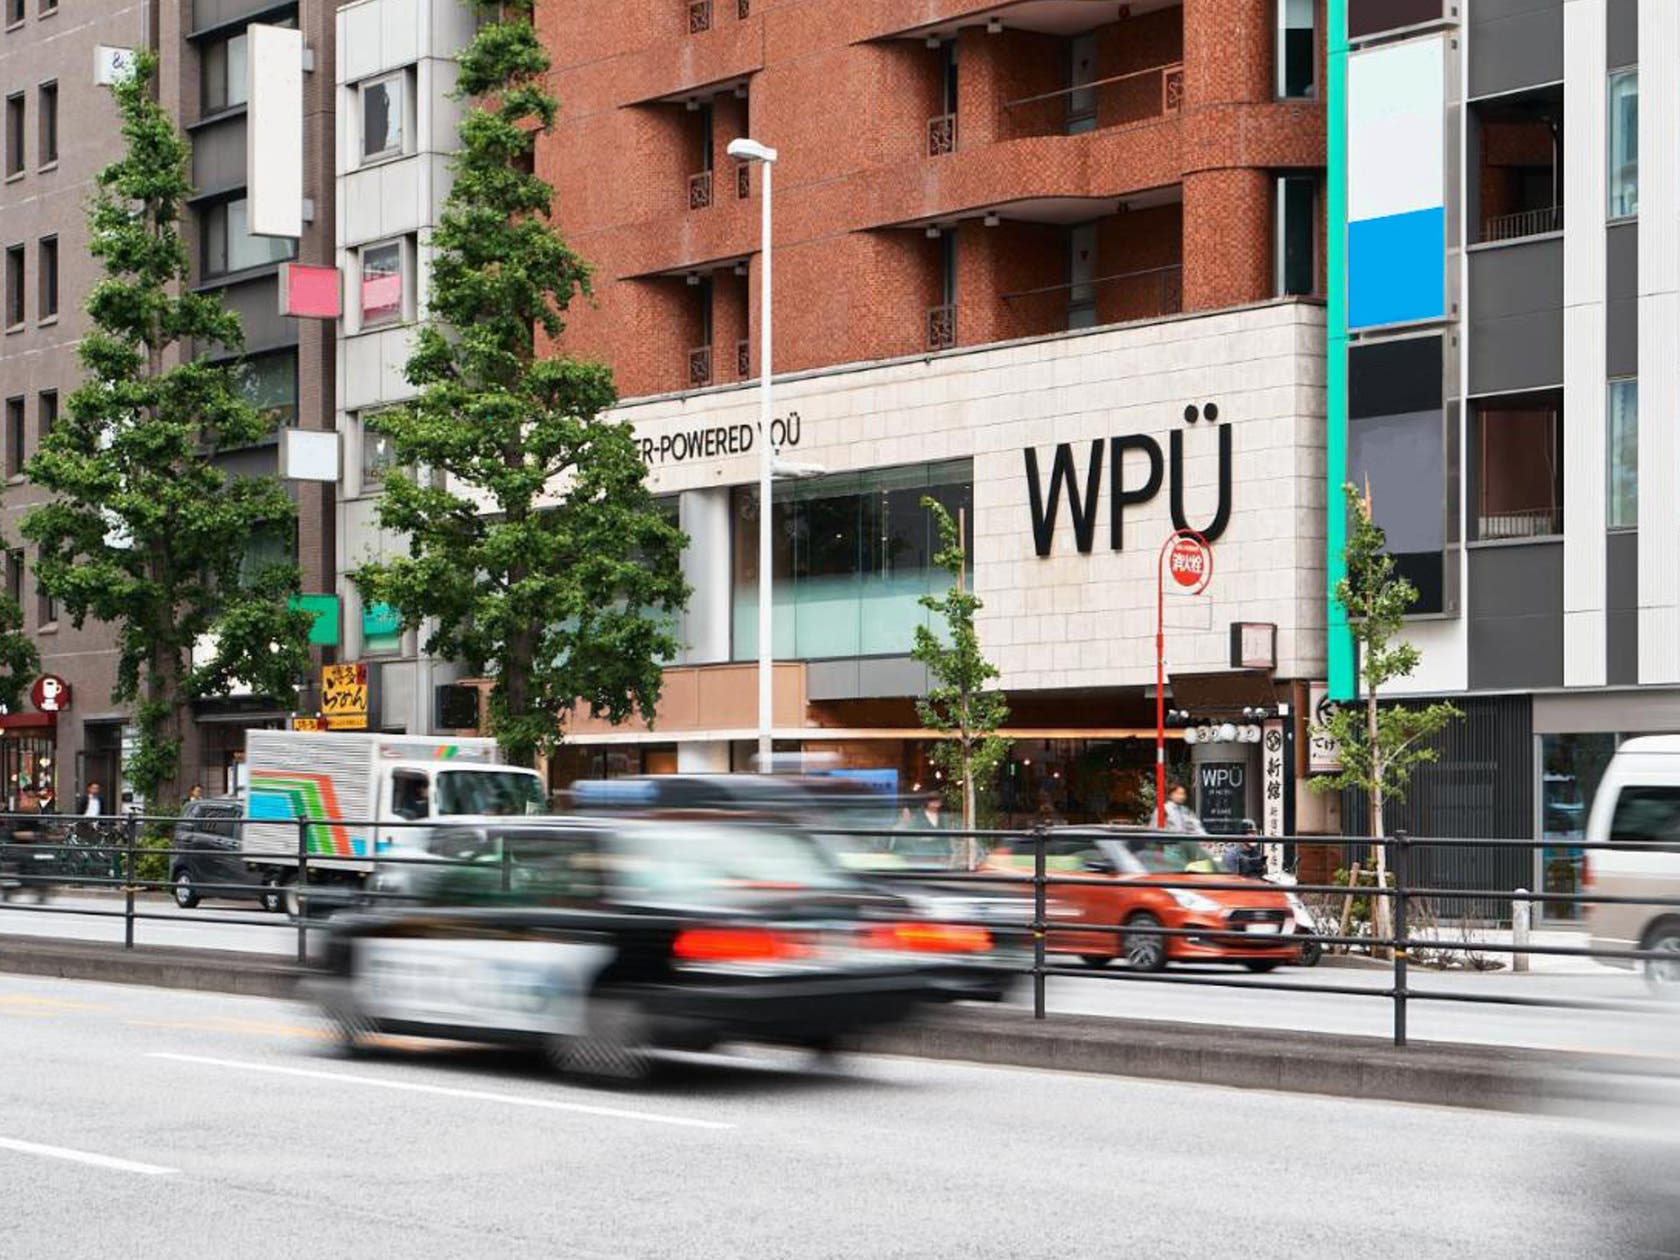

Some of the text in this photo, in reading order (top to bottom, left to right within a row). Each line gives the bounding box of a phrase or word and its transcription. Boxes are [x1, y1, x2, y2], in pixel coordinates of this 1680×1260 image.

[757, 411, 801, 447] OÜ
[1023, 402, 1233, 558] WPÜ
[1202, 765, 1243, 788] WPÜ
